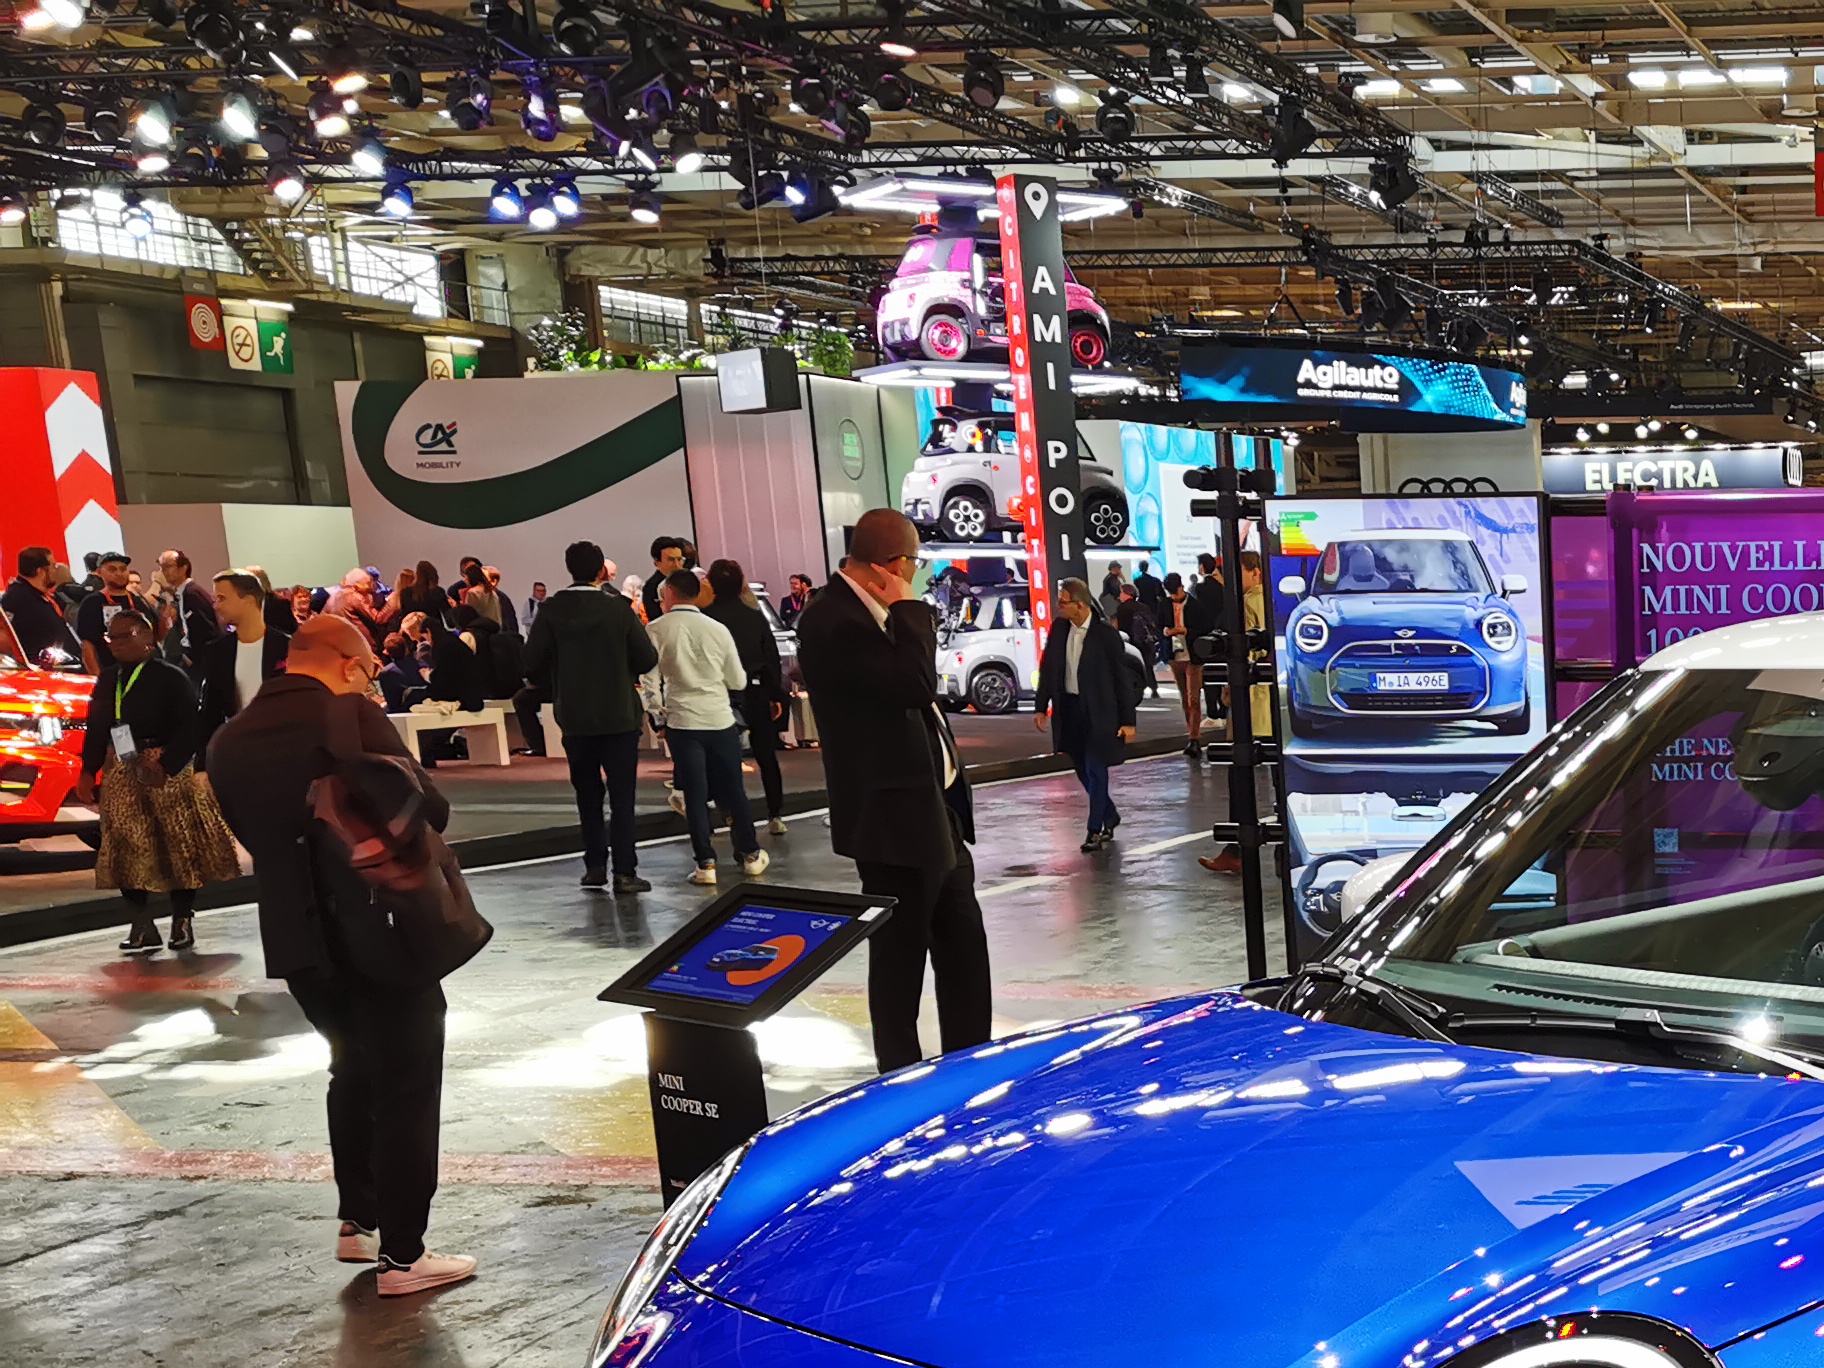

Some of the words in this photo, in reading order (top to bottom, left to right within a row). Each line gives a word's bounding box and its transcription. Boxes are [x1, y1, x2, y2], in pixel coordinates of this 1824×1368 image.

[1031, 264, 1063, 391] AMI
[1297, 358, 1400, 389] Agilauto
[1361, 391, 1400, 403] AGRICOLE
[415, 460, 462, 470] MOBILITY
[1584, 459, 1719, 492] ELECTRA
[1641, 583, 1732, 616] MINI
[1377, 675, 1386, 688] M
[1396, 675, 1411, 687] IA
[1415, 674, 1446, 688] 496E
[1702, 737, 1735, 757] NE
[1650, 762, 1704, 782] MINI
[1709, 761, 1739, 782] CO
[657, 1072, 685, 1092] MINI
[660, 1094, 704, 1117] COOPER
[704, 1101, 720, 1119] SE
